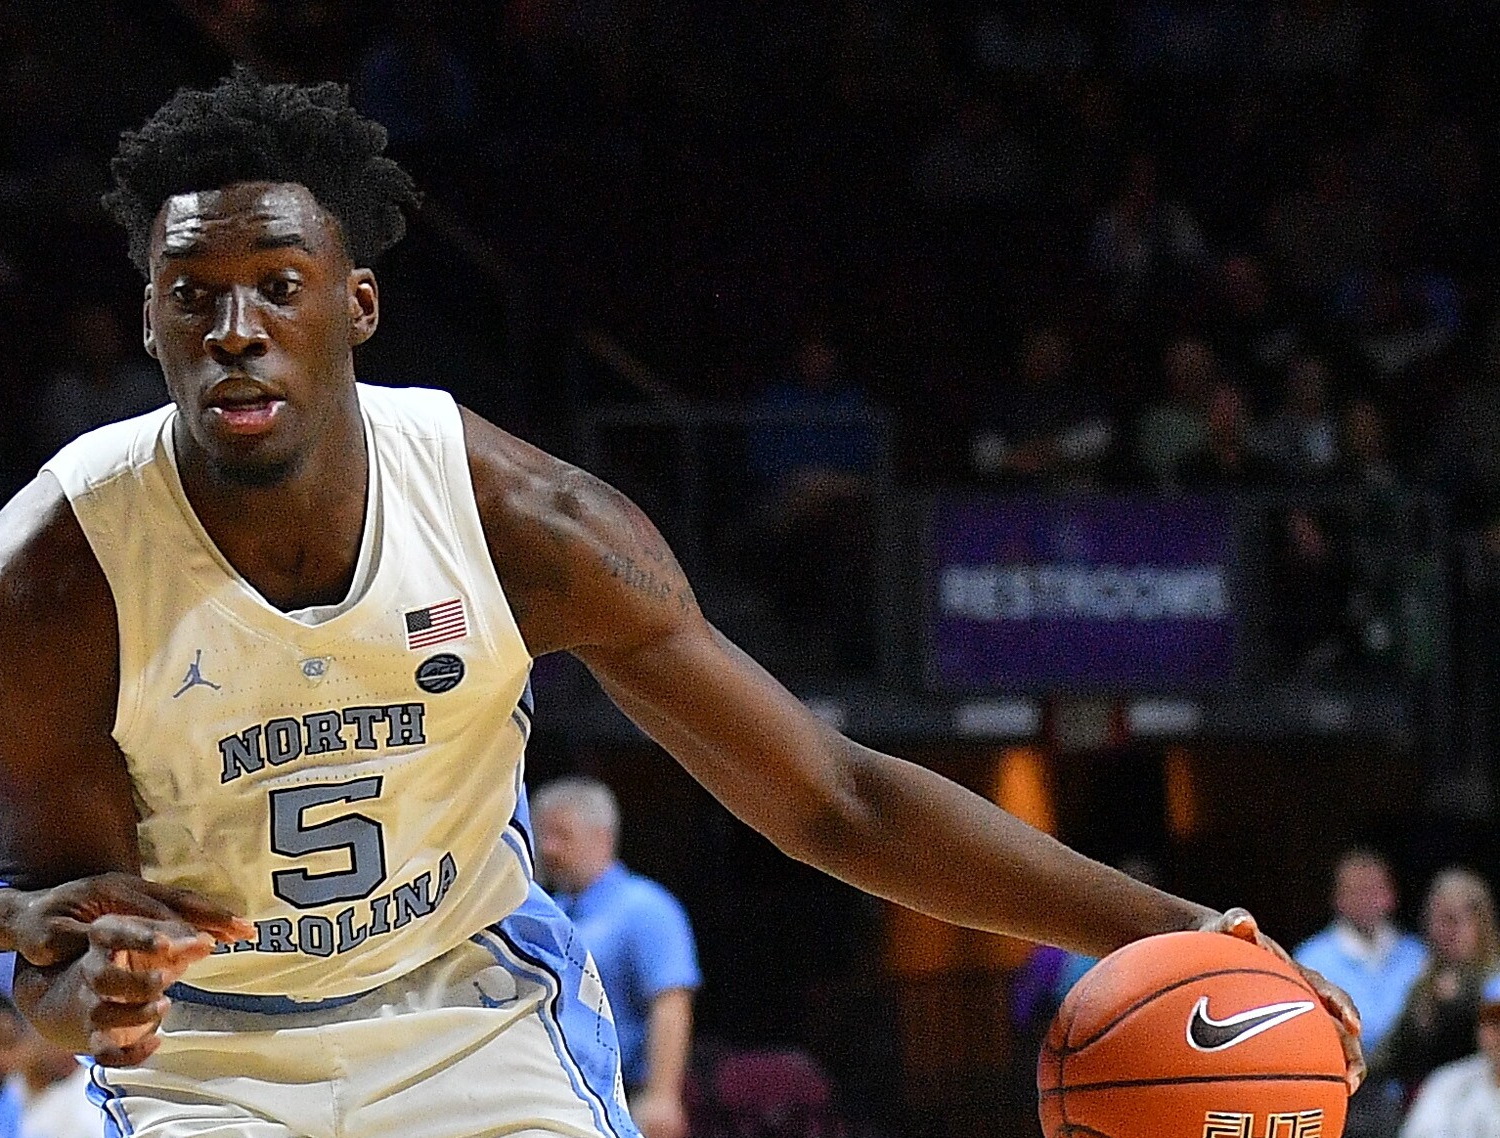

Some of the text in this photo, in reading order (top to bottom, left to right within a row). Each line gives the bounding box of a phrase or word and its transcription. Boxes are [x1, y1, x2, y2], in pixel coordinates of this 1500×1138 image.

[219, 703, 425, 783] NORTH
[269, 776, 386, 909] 5
[209, 852, 457, 957] ROLINA
